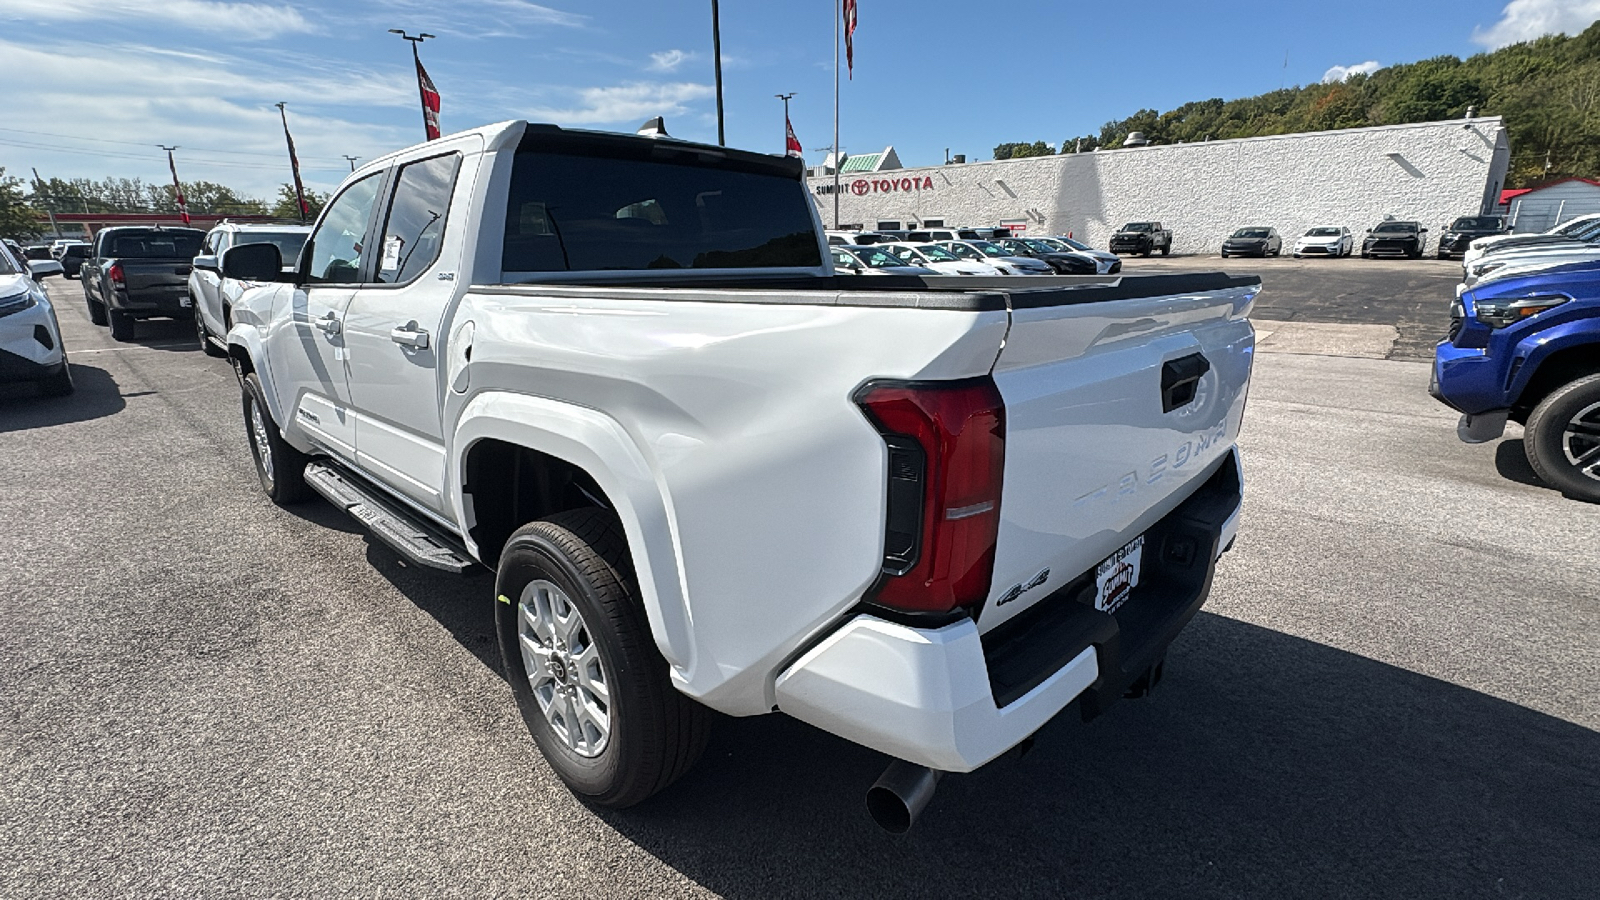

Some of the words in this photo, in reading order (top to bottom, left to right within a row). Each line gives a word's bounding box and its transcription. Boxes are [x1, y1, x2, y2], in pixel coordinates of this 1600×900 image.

[872, 176, 934, 192] TOYOTA
[1073, 418, 1227, 506] TACOMA
[1103, 566, 1132, 604] SUMMIT
